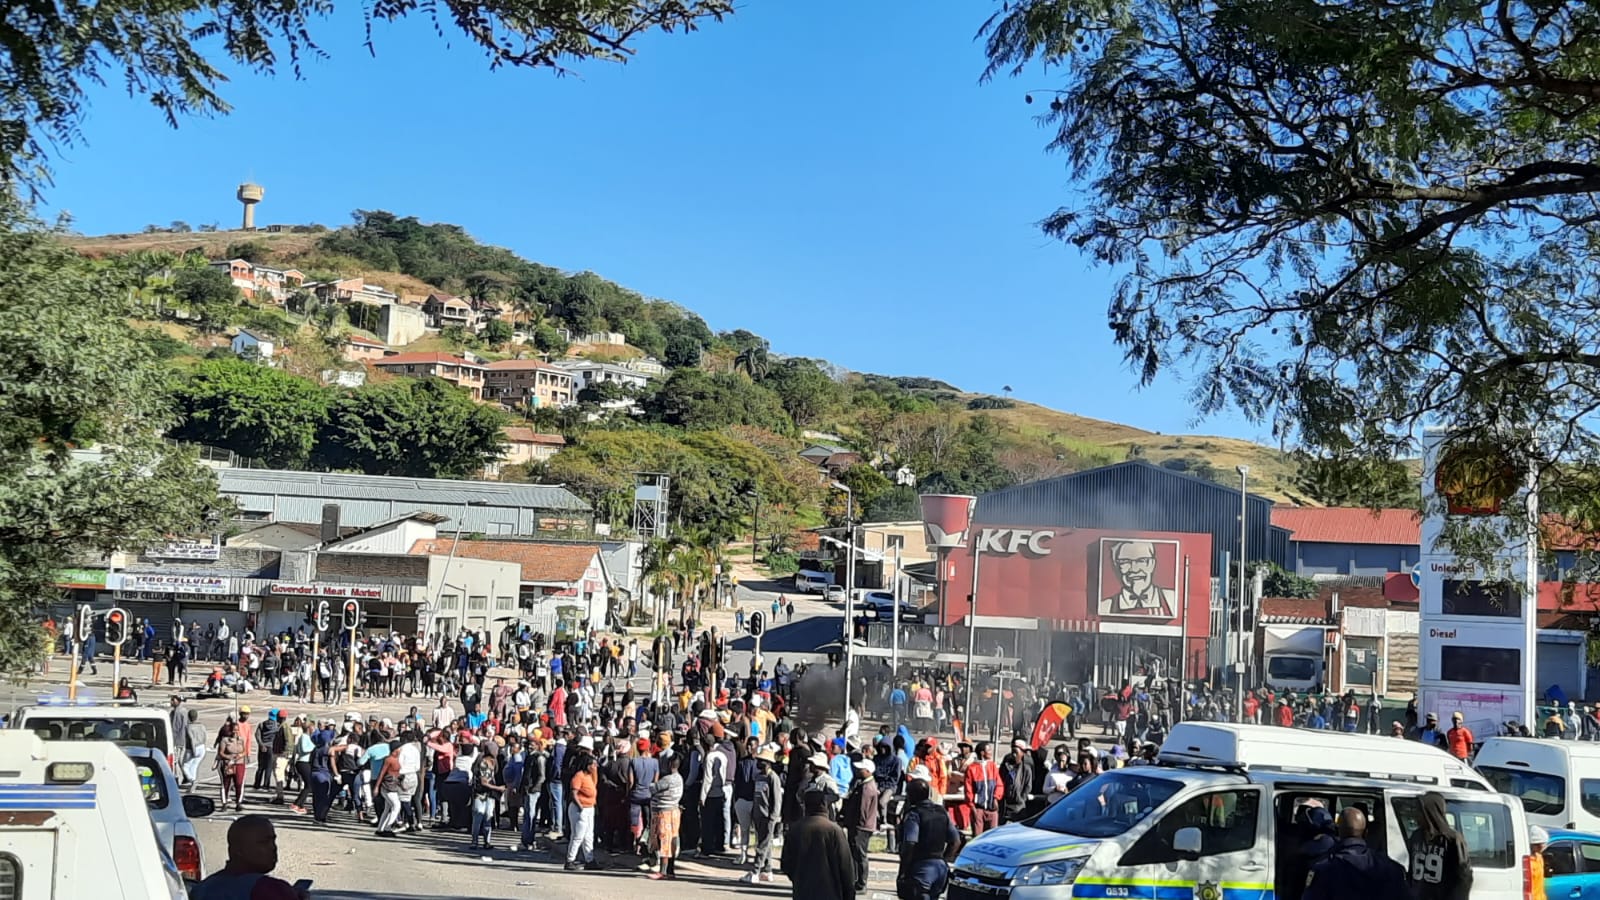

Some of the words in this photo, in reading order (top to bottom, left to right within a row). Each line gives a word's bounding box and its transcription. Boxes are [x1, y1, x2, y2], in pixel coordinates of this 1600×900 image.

[978, 528, 1055, 555] KFC
[166, 577, 222, 585] CELLULAR
[323, 587, 346, 596] Meat
[351, 588, 381, 597] Market
[1429, 628, 1457, 639] Diesel
[1412, 853, 1443, 884] 69
